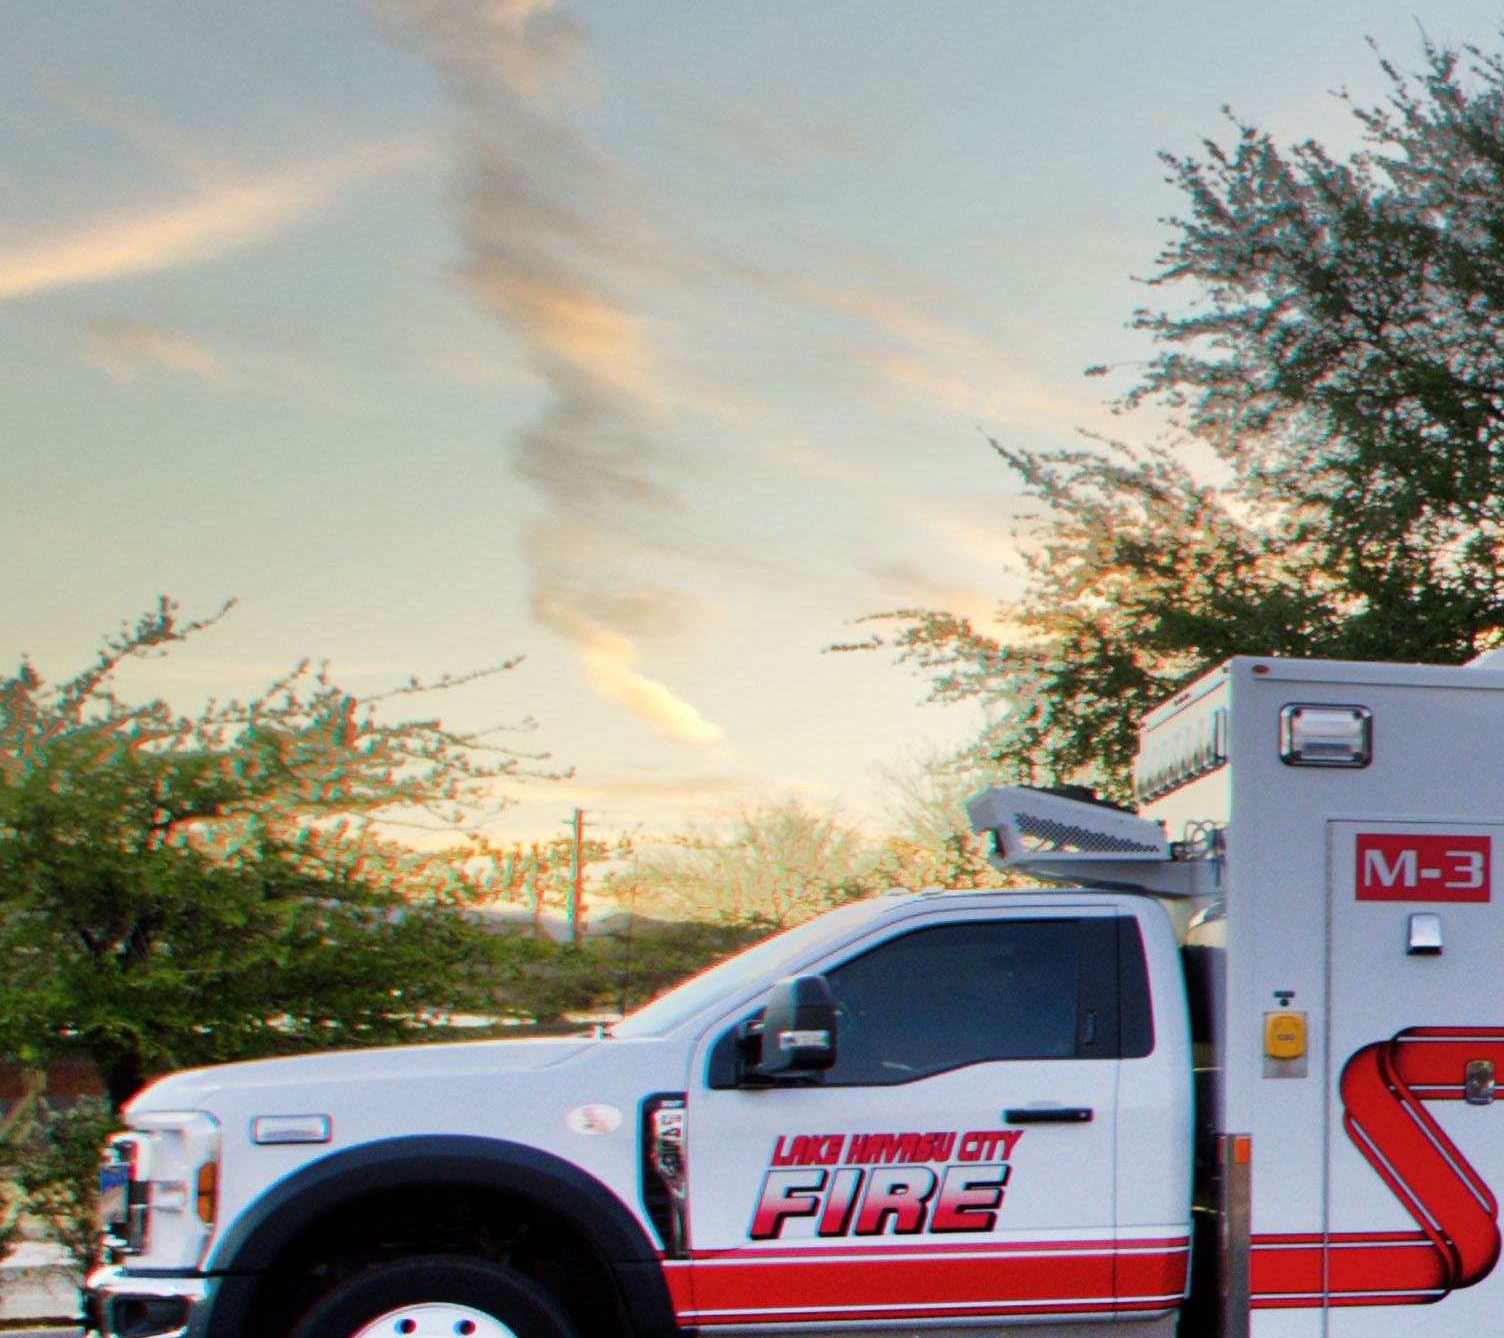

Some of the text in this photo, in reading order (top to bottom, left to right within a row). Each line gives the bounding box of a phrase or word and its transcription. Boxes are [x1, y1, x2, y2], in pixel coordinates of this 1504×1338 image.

[1363, 848, 1485, 889] M-3
[770, 1130, 1024, 1166] LAKE HAVASU CITY
[748, 1164, 1012, 1240] FIRE
